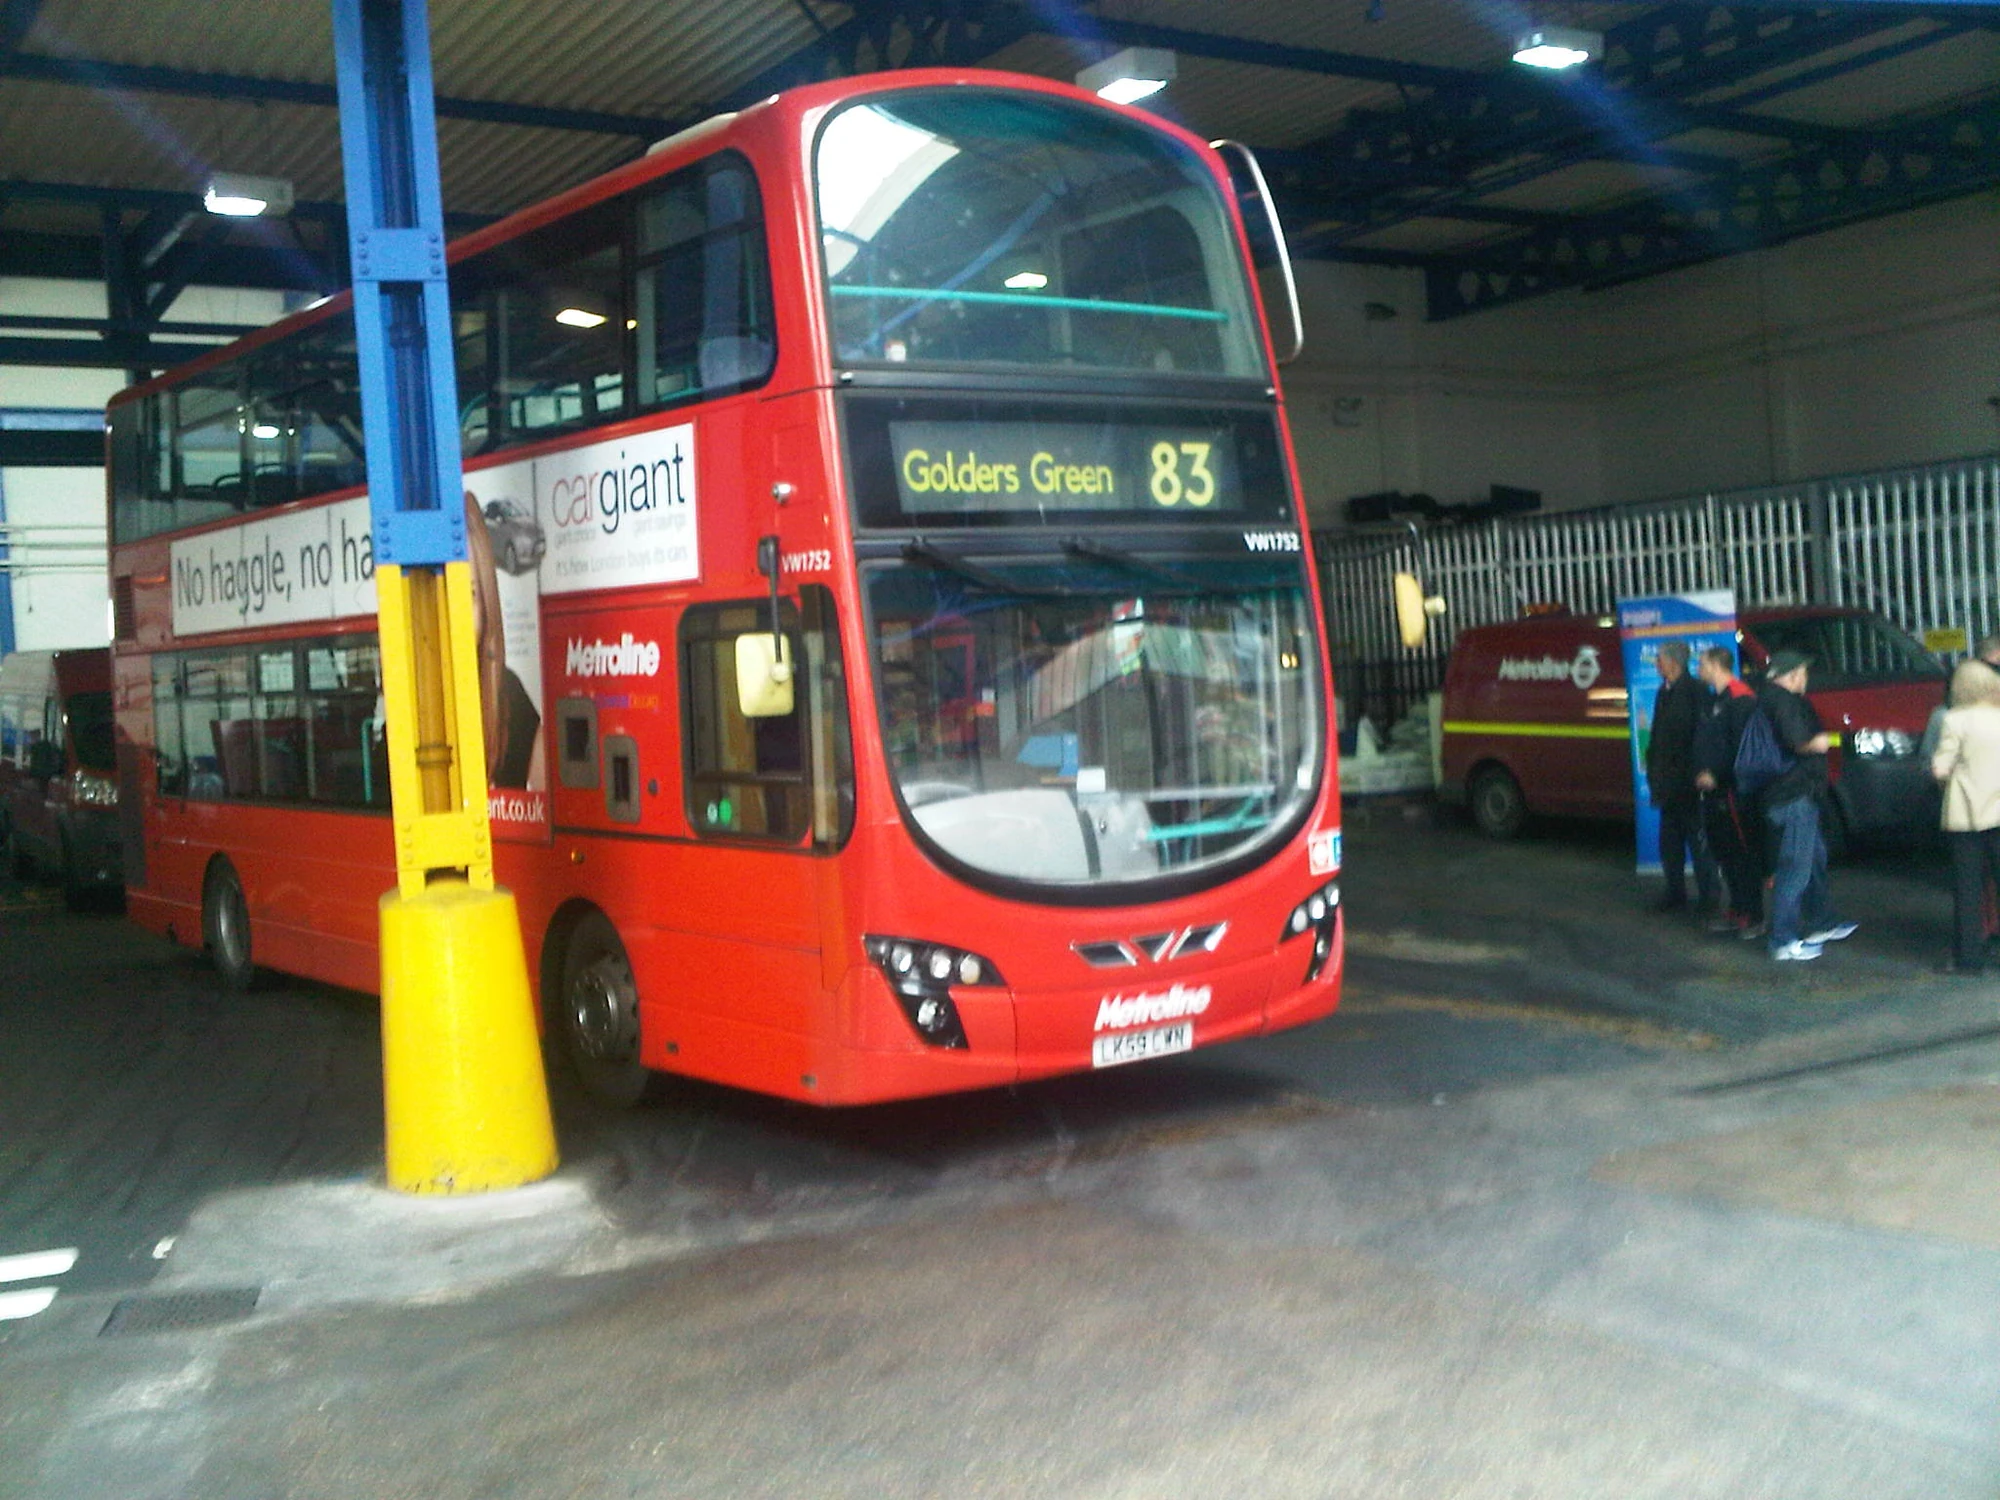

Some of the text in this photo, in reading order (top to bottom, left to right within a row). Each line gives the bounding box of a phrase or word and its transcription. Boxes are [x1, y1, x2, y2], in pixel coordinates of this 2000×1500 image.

[552, 442, 685, 534] cargiant
[903, 449, 1114, 494] Golders Green
[1150, 441, 1215, 507] 83
[177, 557, 204, 608] No
[210, 534, 291, 615] haggle,
[301, 542, 332, 588] no
[565, 632, 660, 677] Metroline
[1094, 983, 1212, 1032] Metroline
